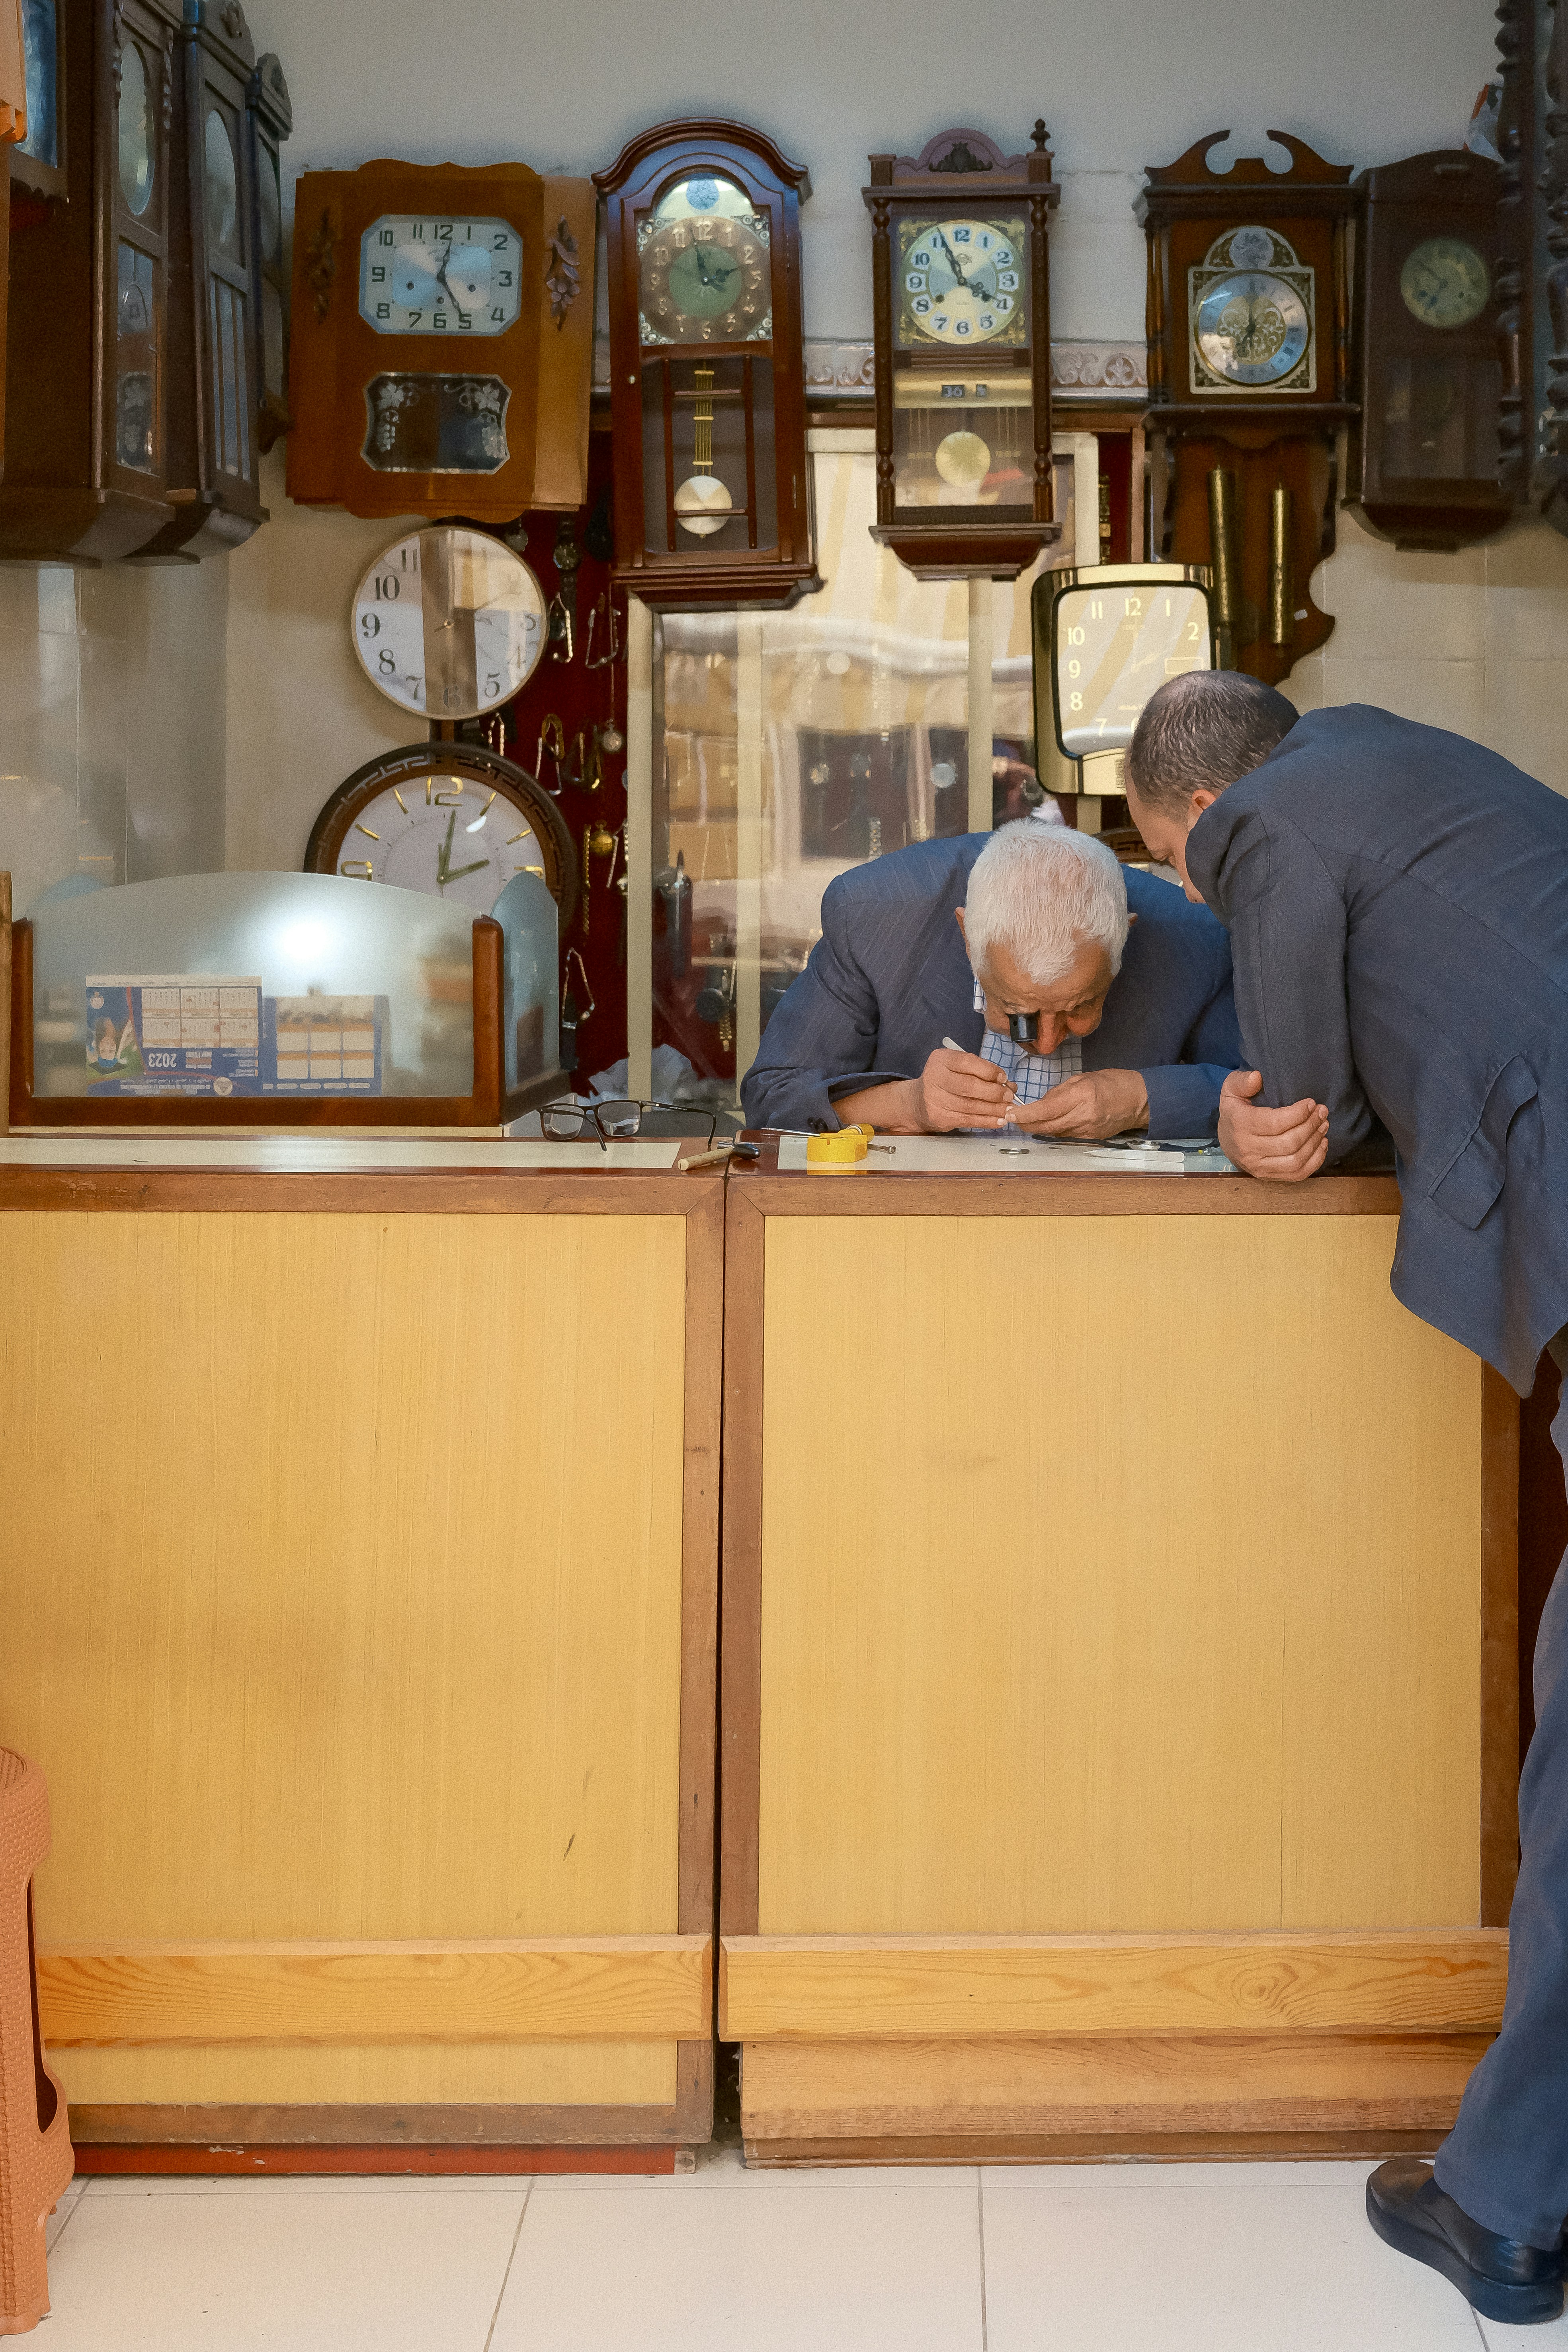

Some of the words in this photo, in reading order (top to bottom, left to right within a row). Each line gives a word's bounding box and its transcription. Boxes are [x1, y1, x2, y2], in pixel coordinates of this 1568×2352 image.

[379, 230, 393, 246] 10
[413, 224, 423, 239] 11
[434, 224, 453, 240] 12
[467, 225, 471, 240] 1
[955, 229, 970, 242] 12
[494, 234, 508, 250] 2
[983, 236, 989, 248] 1
[744, 244, 754, 265] 2
[916, 253, 930, 265] 10
[996, 252, 1010, 264] 2
[372, 266, 385, 282] 9
[499, 271, 512, 287] 3
[1003, 274, 1014, 287] 3
[910, 276, 922, 289] 9
[377, 303, 390, 318] 8
[916, 299, 929, 312] 8
[996, 298, 1008, 310] 4
[409, 312, 422, 328] 7
[433, 313, 447, 328] 6
[459, 314, 472, 329] 5
[491, 308, 505, 322] 4
[980, 315, 993, 329] 5
[934, 317, 947, 330] 7
[957, 321, 969, 334] 6
[400, 548, 417, 572] 11
[375, 574, 400, 601] 10
[1092, 601, 1103, 619] 11
[1125, 597, 1141, 616] 12
[1166, 599, 1170, 617] 1
[362, 613, 380, 638] 9
[1187, 622, 1199, 640] 2
[1068, 626, 1086, 646] 10
[379, 649, 396, 675] 8
[1068, 660, 1081, 678] 9
[406, 675, 422, 700] 7
[484, 673, 500, 697] 5
[443, 685, 461, 709] 6
[1070, 691, 1083, 711] 8
[1095, 718, 1107, 736] 7
[425, 777, 463, 806] 12
[148, 1053, 177, 1067] 2023
